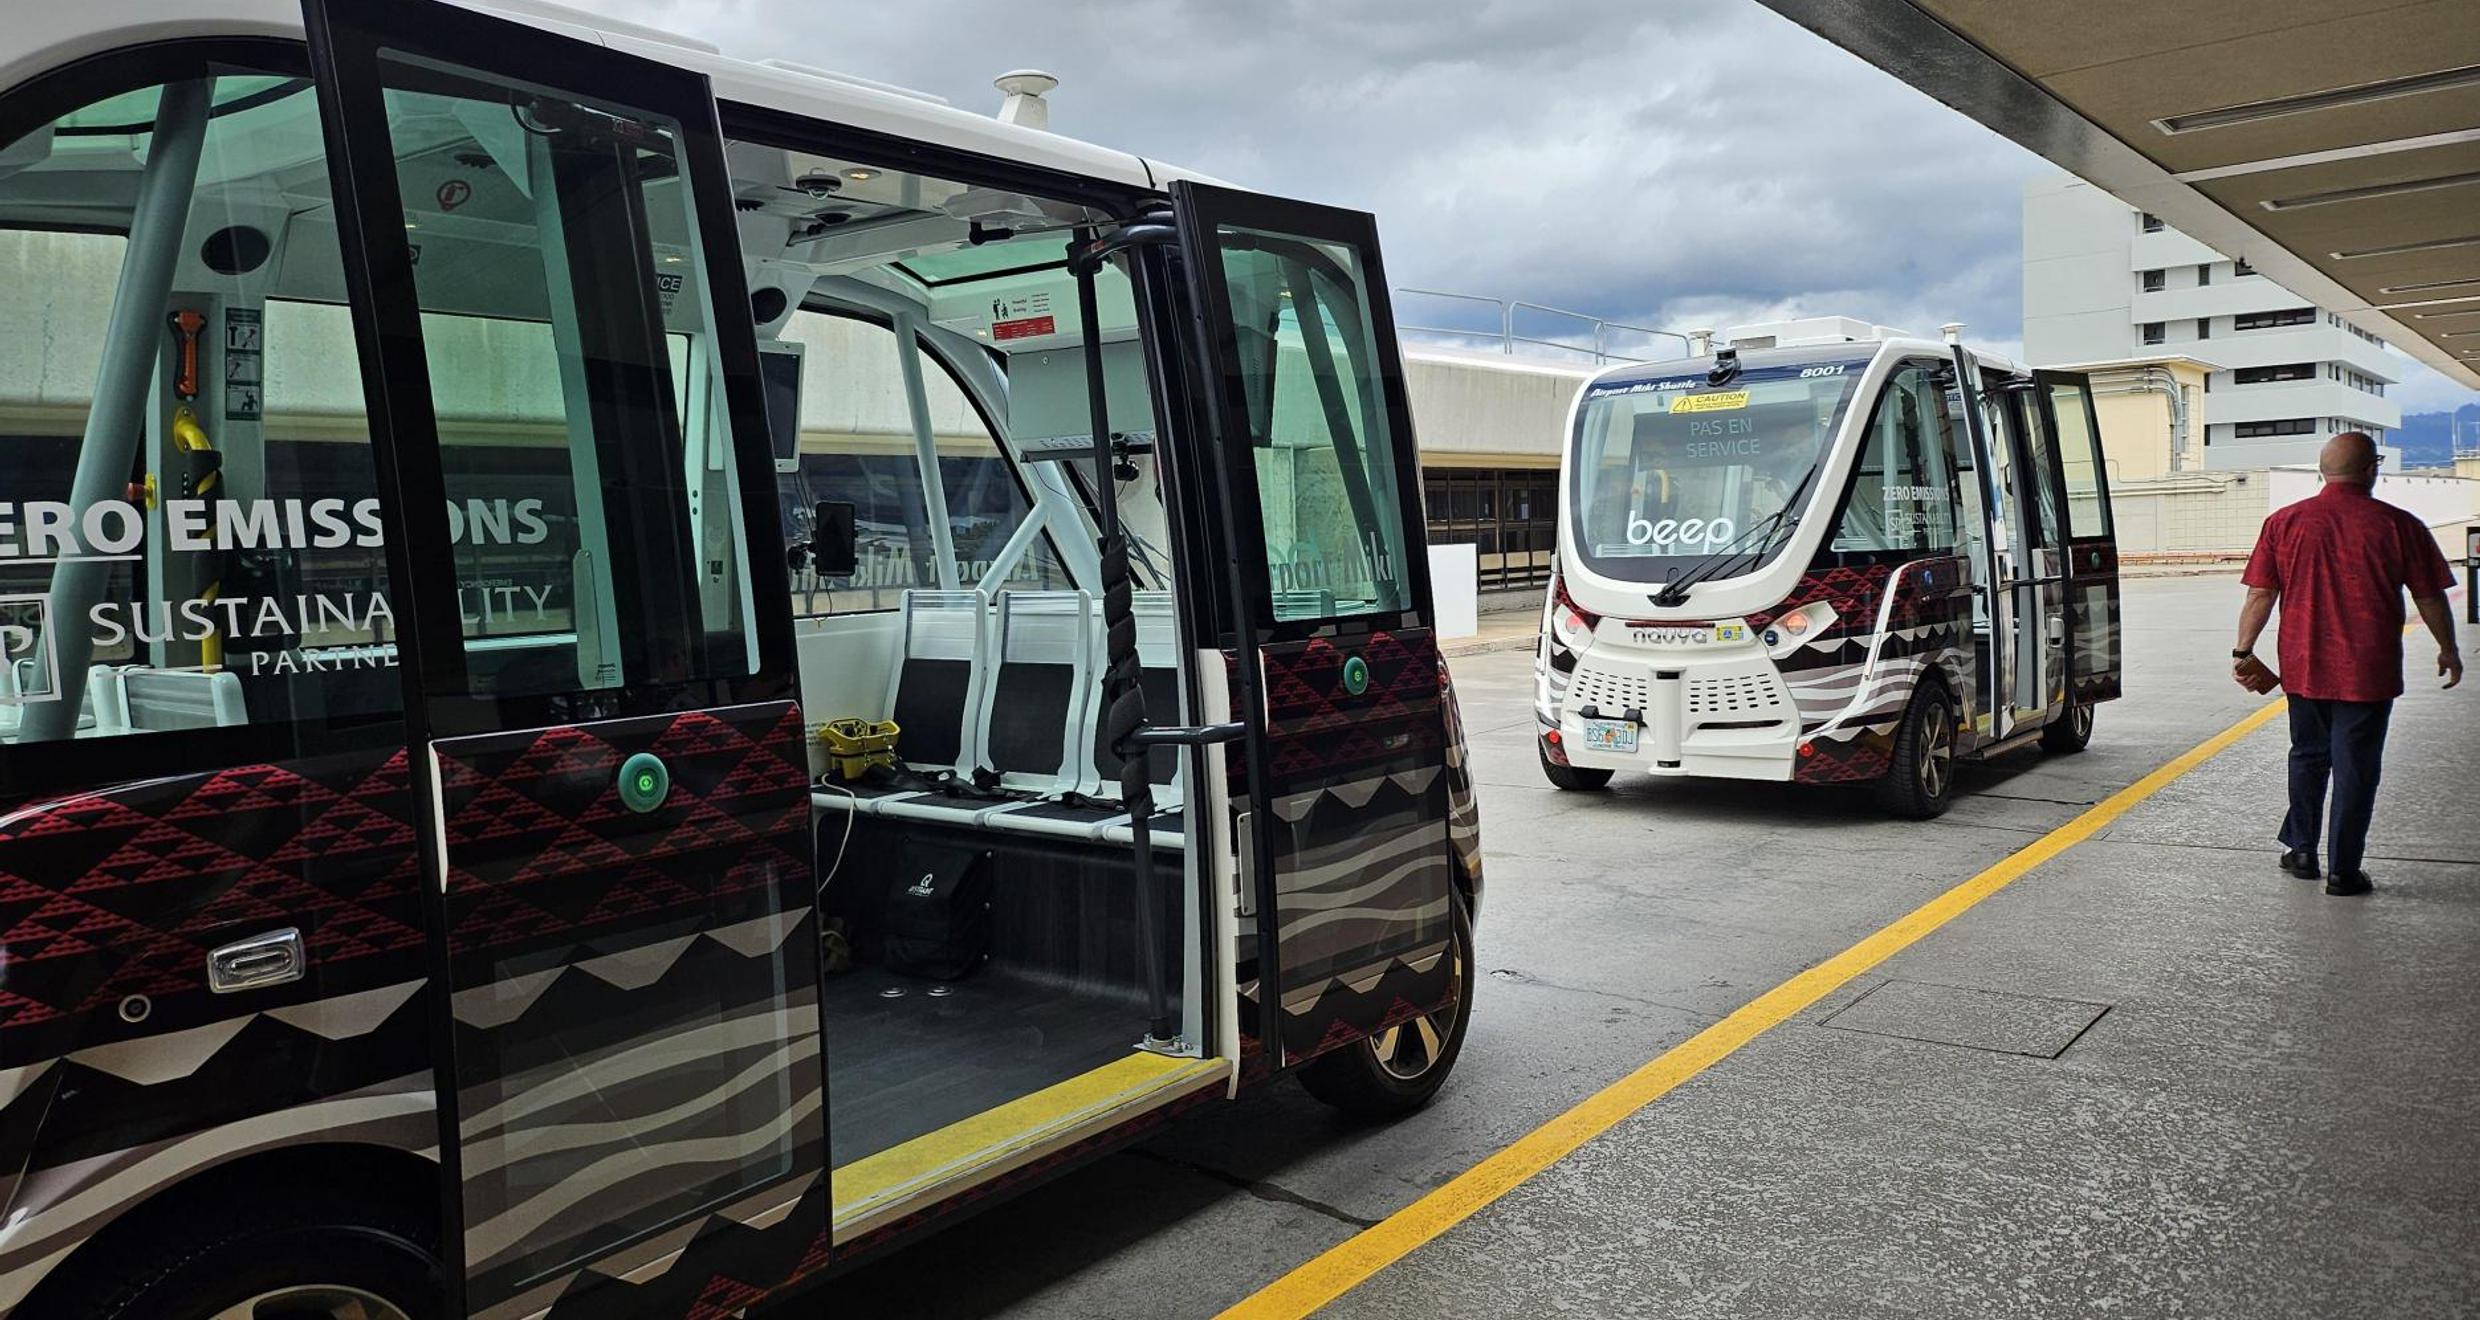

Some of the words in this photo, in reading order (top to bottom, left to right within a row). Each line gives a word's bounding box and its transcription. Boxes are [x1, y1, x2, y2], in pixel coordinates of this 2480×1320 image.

[1800, 364, 1845, 378] 8001
[1591, 387, 1629, 398] Airport
[1657, 379, 1697, 391] Shuttle
[1697, 392, 1746, 403] CAUTION
[1690, 420, 1723, 436] PAS
[1728, 417, 1753, 434] EN
[1686, 439, 1761, 458] SERVICE
[1882, 486, 1910, 501] ZERO
[166, 498, 548, 551] EMISSNS
[1627, 510, 1735, 555] beep
[89, 584, 552, 647] SUSTAINALITY
[252, 643, 400, 676] PARTNE
